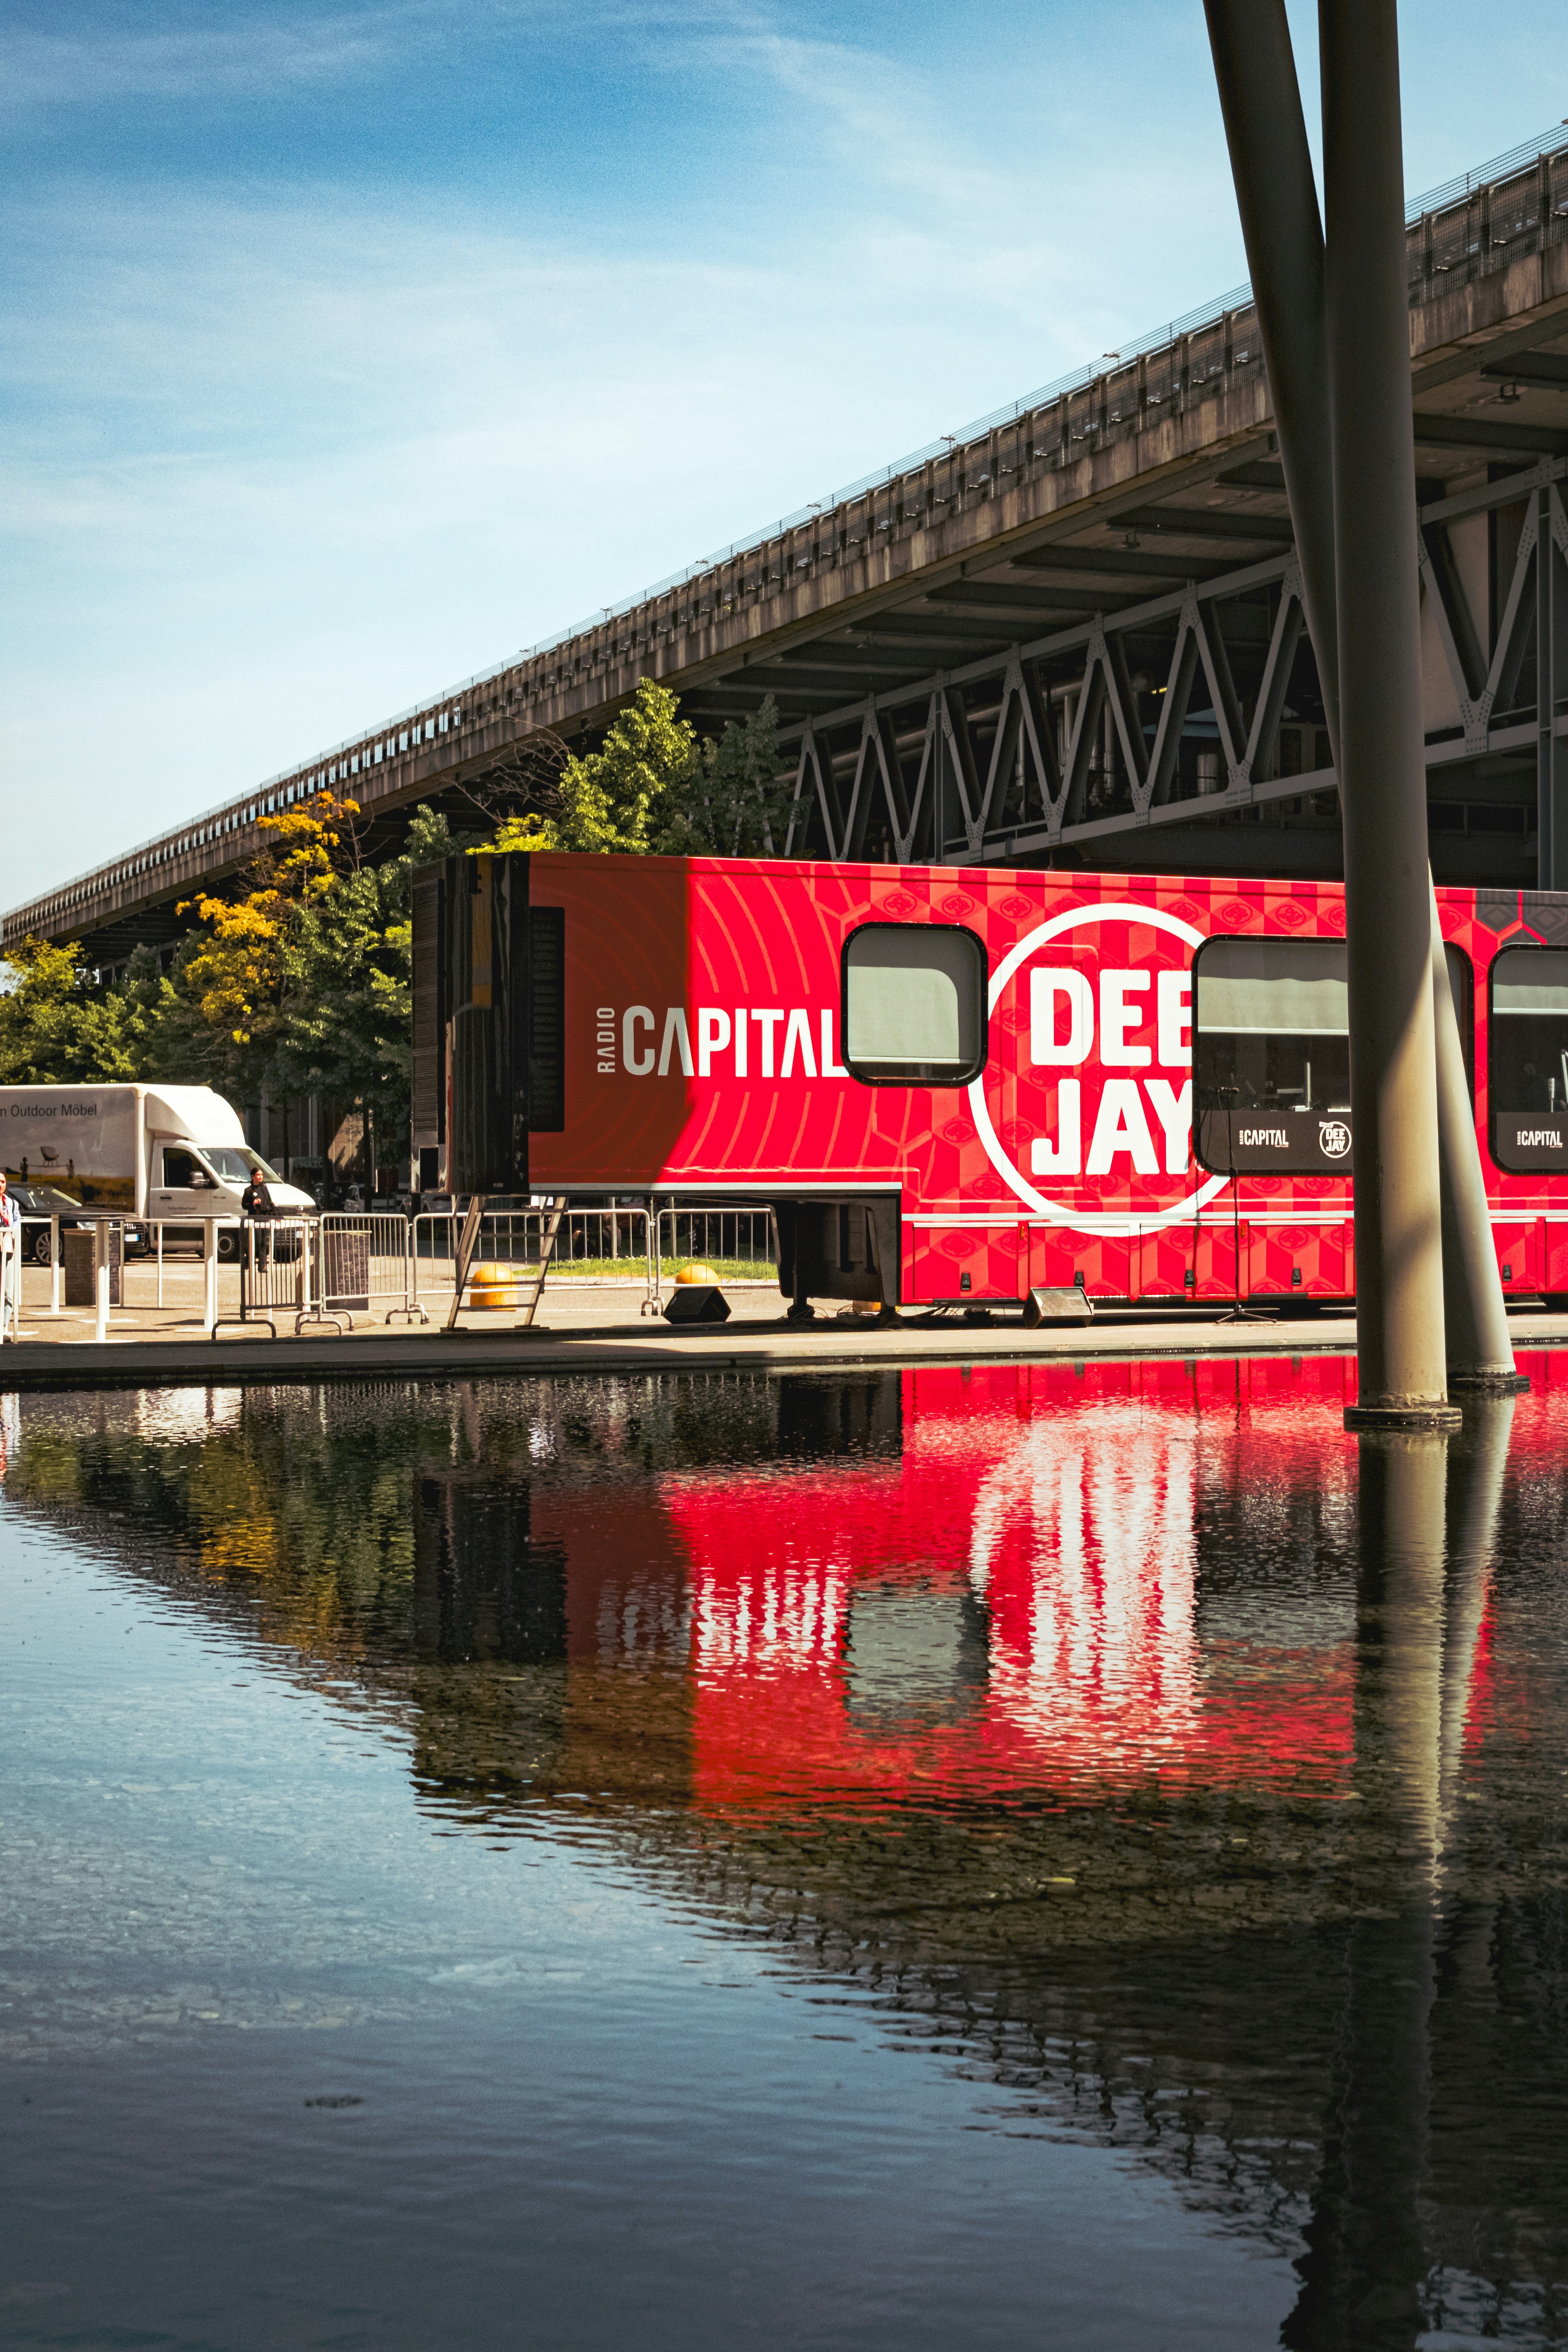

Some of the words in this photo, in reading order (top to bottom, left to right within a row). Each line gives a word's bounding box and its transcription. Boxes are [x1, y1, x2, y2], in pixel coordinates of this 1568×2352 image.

[1030, 968, 1192, 1066] DEE
[597, 1007, 615, 1073] RADIO
[623, 1005, 849, 1077] CAPITAL
[11, 1105, 57, 1117] Outdoor
[62, 1104, 97, 1116] Möbel
[1031, 1079, 1193, 1175] JAY
[1244, 1130, 1289, 1145] CAPITAL
[1326, 1128, 1346, 1140] DEE
[1521, 1131, 1563, 1146] CAPITAL
